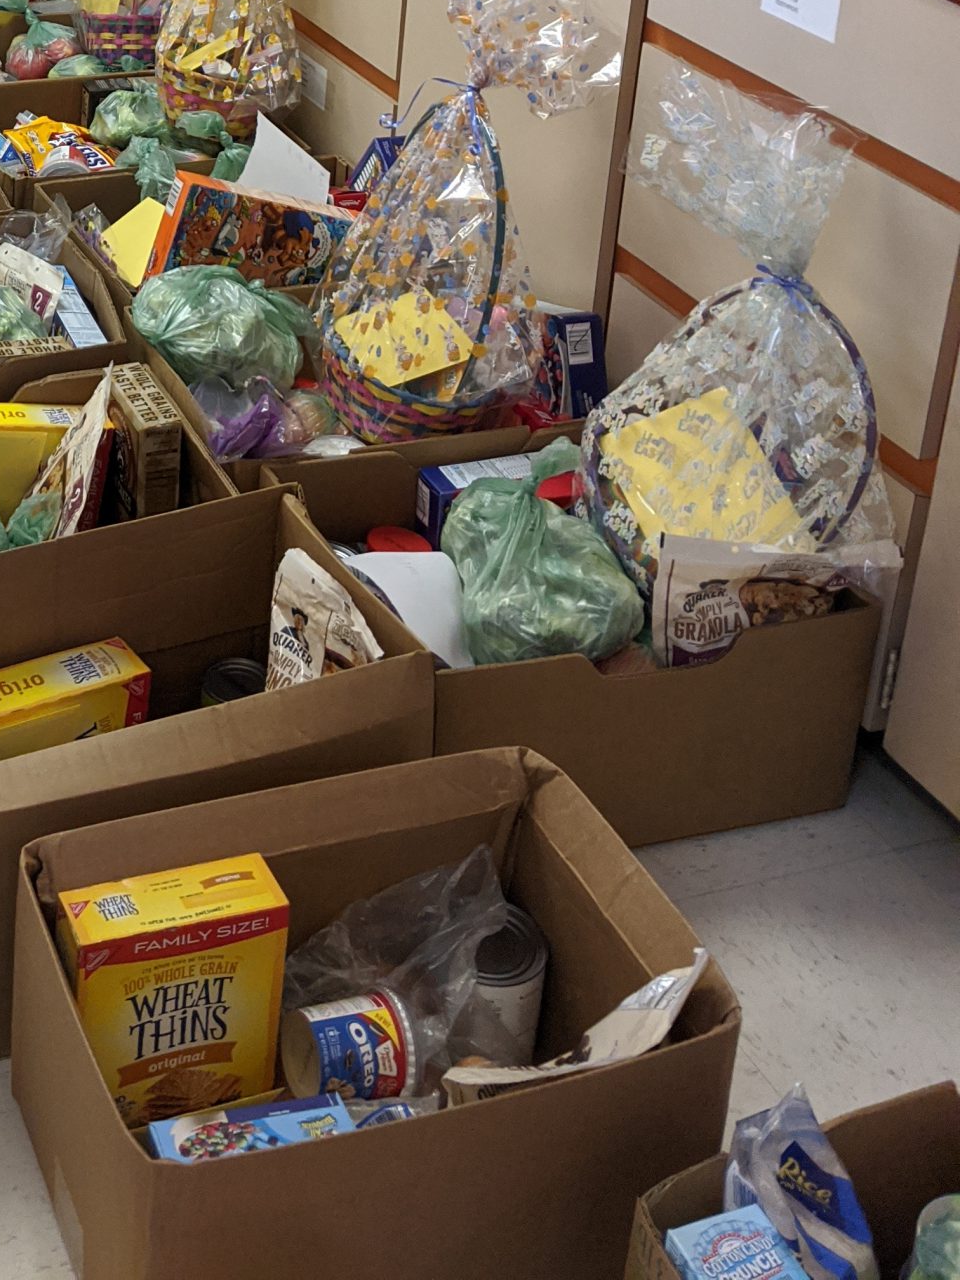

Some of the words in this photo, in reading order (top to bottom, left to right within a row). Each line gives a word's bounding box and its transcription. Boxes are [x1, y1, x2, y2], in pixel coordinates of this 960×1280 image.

[33, 291, 43, 311] 2
[16, 337, 60, 347] TASTE
[18, 343, 66, 356] WHOLE
[112, 368, 132, 393] TASTE
[128, 392, 159, 423] BETTER
[128, 364, 156, 392] WHOLE
[147, 391, 178, 420] GRAINS
[683, 588, 727, 613] QUAKER
[674, 614, 742, 642] GRANOLA
[273, 631, 313, 668] QUAKER
[92, 893, 133, 911] WHEAT
[133, 928, 213, 955] FAMILY
[216, 916, 271, 939] SIZE!
[123, 975, 152, 996] 100%
[153, 964, 196, 988] WHOLE
[199, 961, 240, 977] GRAIN
[126, 976, 234, 1020] WHEAT
[148, 1050, 206, 1074] original
[348, 1021, 375, 1088] OREO
[777, 1156, 833, 1205] Rice
[702, 1245, 743, 1278] COTTON
[743, 1234, 776, 1259] CANDY
